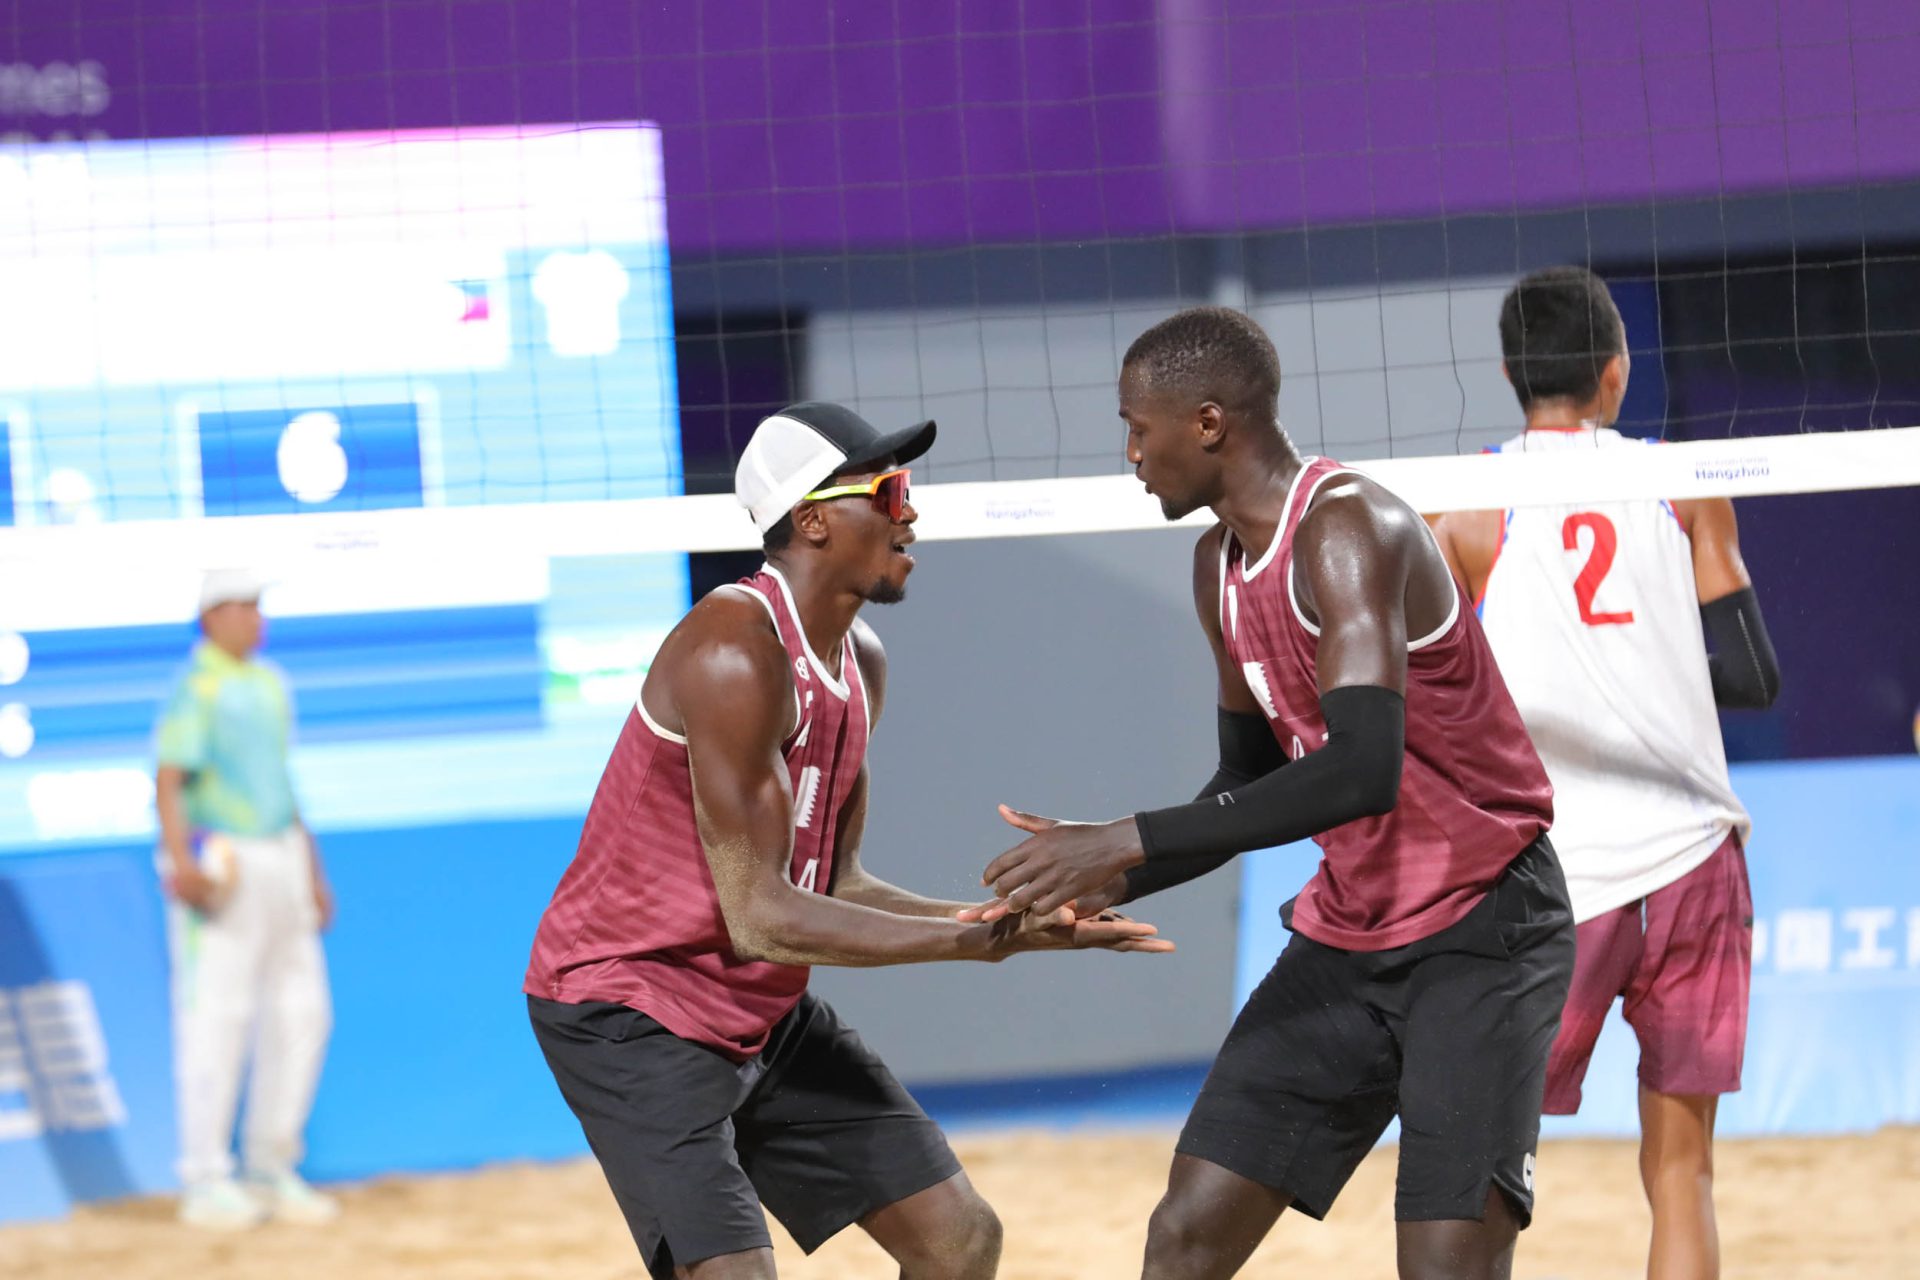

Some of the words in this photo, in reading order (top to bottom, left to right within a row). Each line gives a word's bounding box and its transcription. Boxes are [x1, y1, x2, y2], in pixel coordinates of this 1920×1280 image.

[277, 410, 348, 503] 6
[1695, 466, 1769, 480] Hangzhou
[1562, 512, 1634, 626] 2
